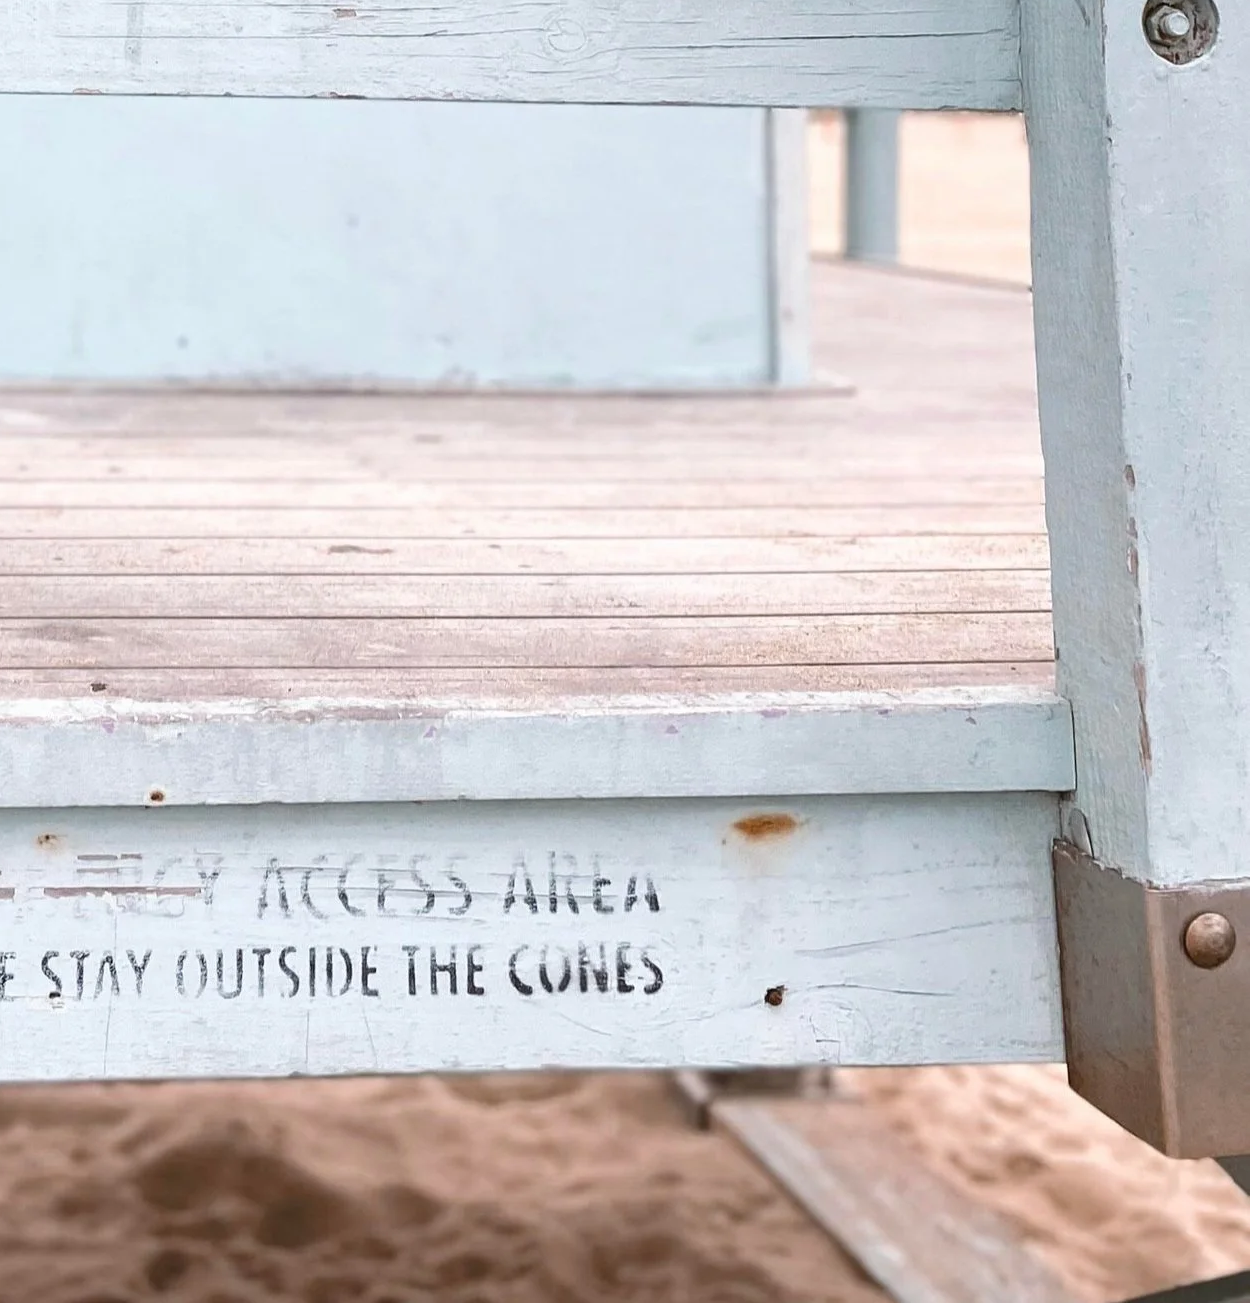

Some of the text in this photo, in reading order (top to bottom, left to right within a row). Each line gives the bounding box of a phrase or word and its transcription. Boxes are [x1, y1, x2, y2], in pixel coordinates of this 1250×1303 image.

[502, 849, 662, 915] AREA
[41, 948, 153, 1000] STAY
[175, 946, 379, 1000] OUTSIDE
[401, 944, 486, 997] THE
[508, 941, 665, 997] CONES
